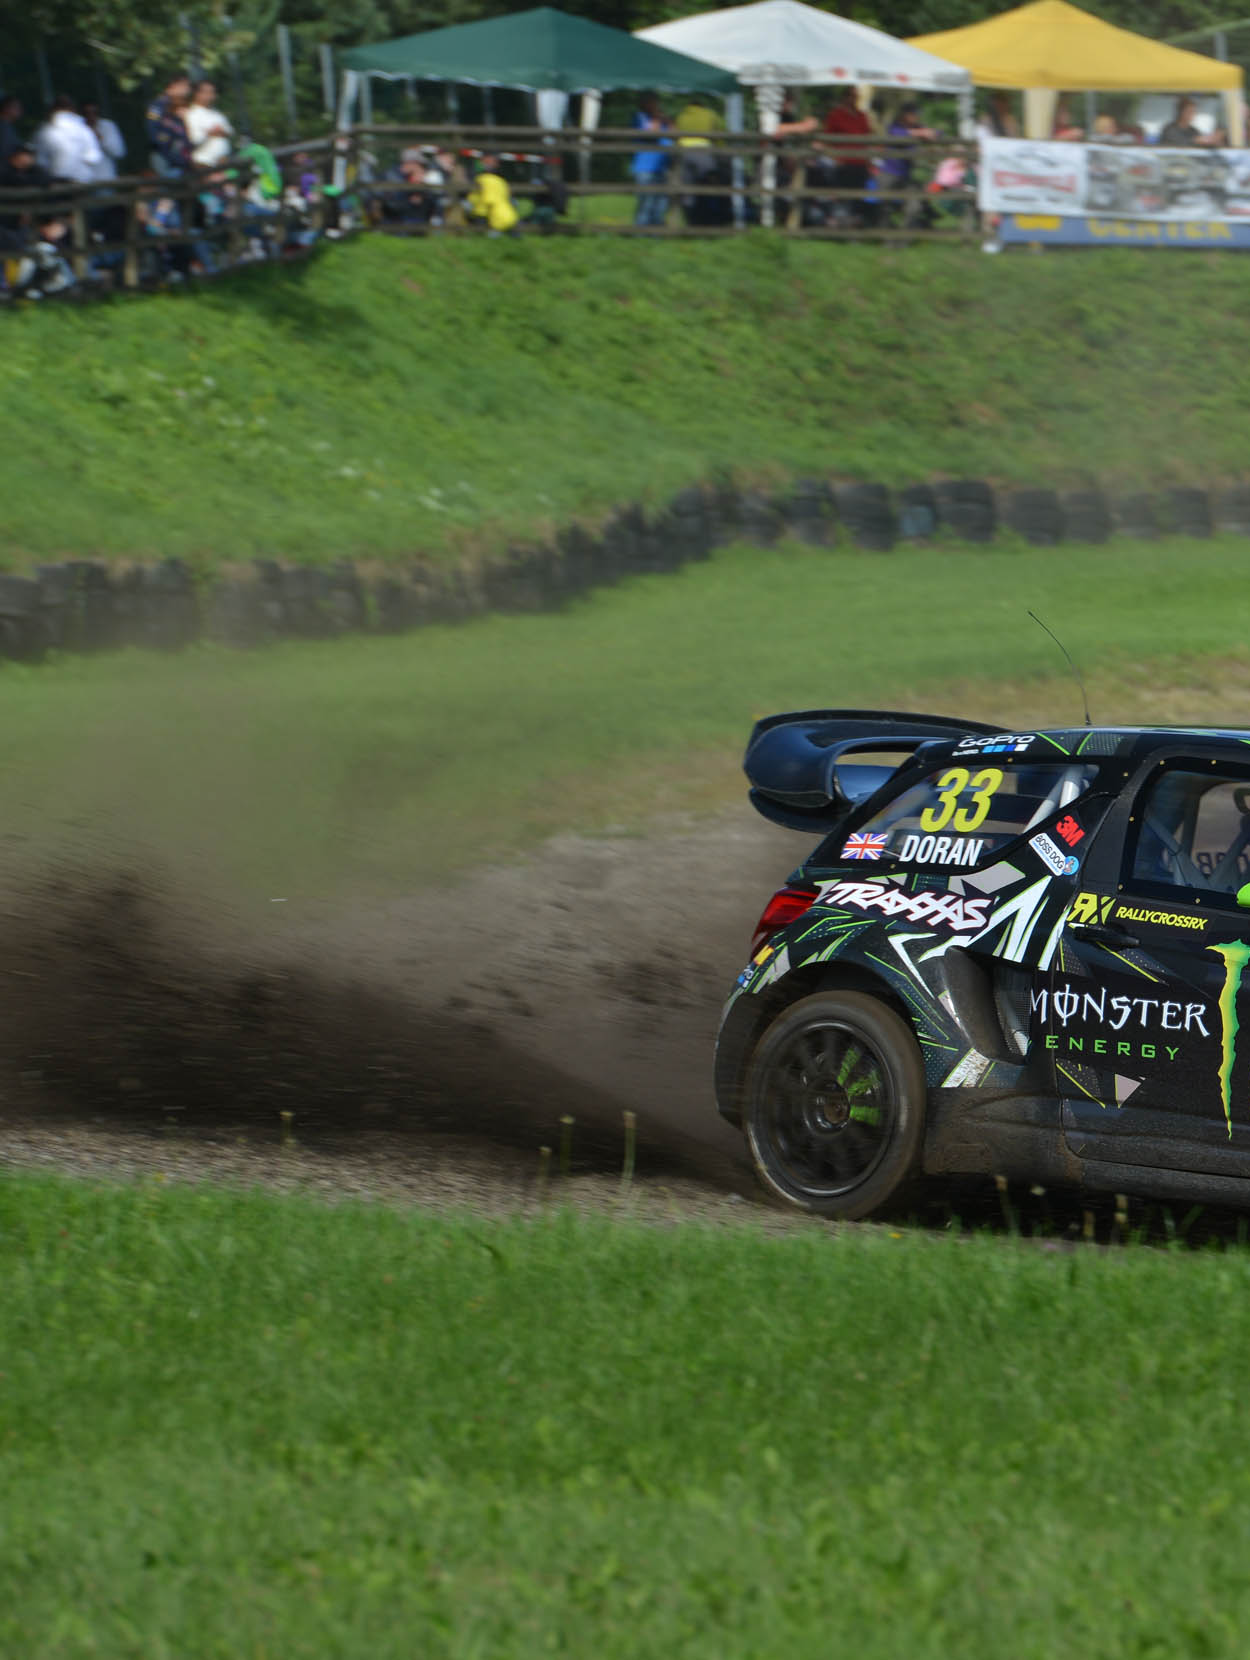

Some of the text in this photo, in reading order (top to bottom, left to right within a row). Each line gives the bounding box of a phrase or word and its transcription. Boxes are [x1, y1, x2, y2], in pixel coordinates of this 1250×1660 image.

[958, 735, 1036, 747] GoPro
[920, 767, 1003, 832] 33
[1056, 815, 1086, 847] 3M
[899, 835, 985, 867] DORAN
[1034, 834, 1053, 855] BOSS
[1048, 851, 1065, 869] DOG
[825, 881, 993, 931] TRAXXAS
[1115, 906, 1209, 931] RALLYCROSSRX
[1029, 984, 1210, 1037] MONSTER
[1045, 1034, 1180, 1061] ENERGY
